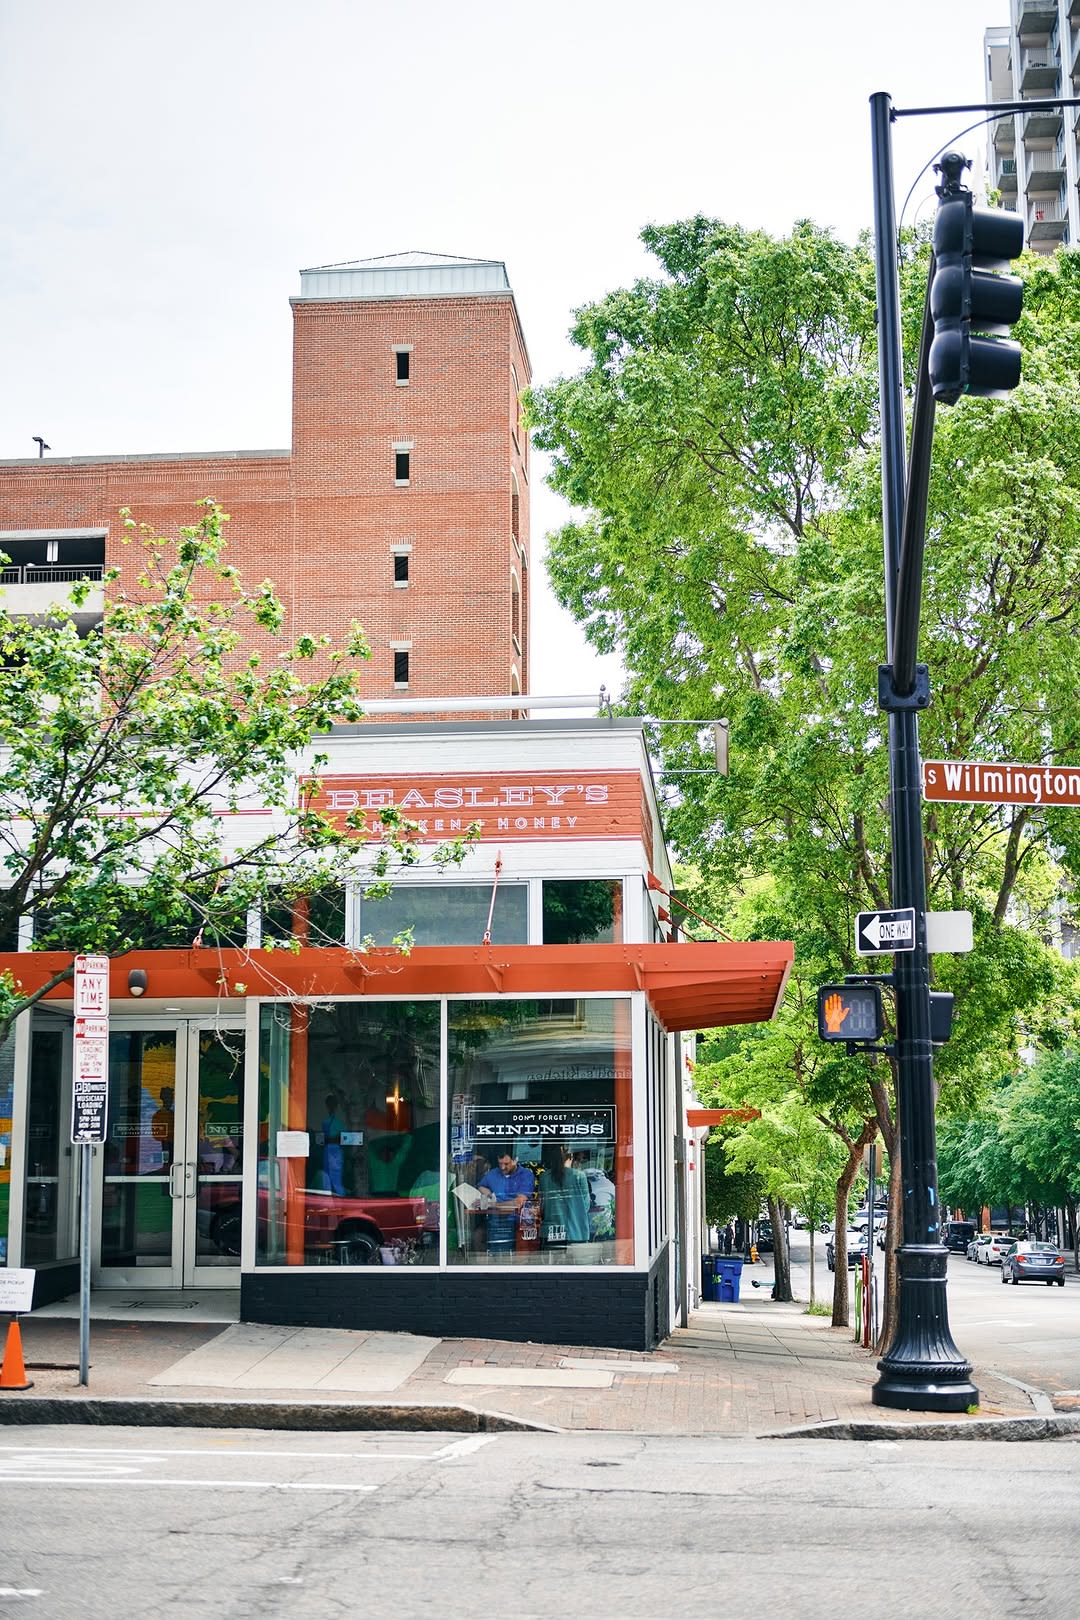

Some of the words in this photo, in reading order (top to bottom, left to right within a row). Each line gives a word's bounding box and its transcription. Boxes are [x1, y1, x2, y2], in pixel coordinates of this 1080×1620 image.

[928, 769, 937, 785] S
[944, 764, 1080, 803] Wilmington
[326, 784, 609, 810] BEASLEY'S
[498, 816, 578, 830] HONEY
[879, 924, 895, 939] ONE
[896, 923, 910, 938] WAY
[87, 960, 107, 970] PARKING
[82, 978, 102, 989] ANY
[80, 992, 103, 1004] TIME
[83, 1082, 91, 1093] 30
[77, 1101, 103, 1109] LOADING
[82, 1108, 98, 1116] ONLY
[476, 1124, 604, 1135] KINDNESS
